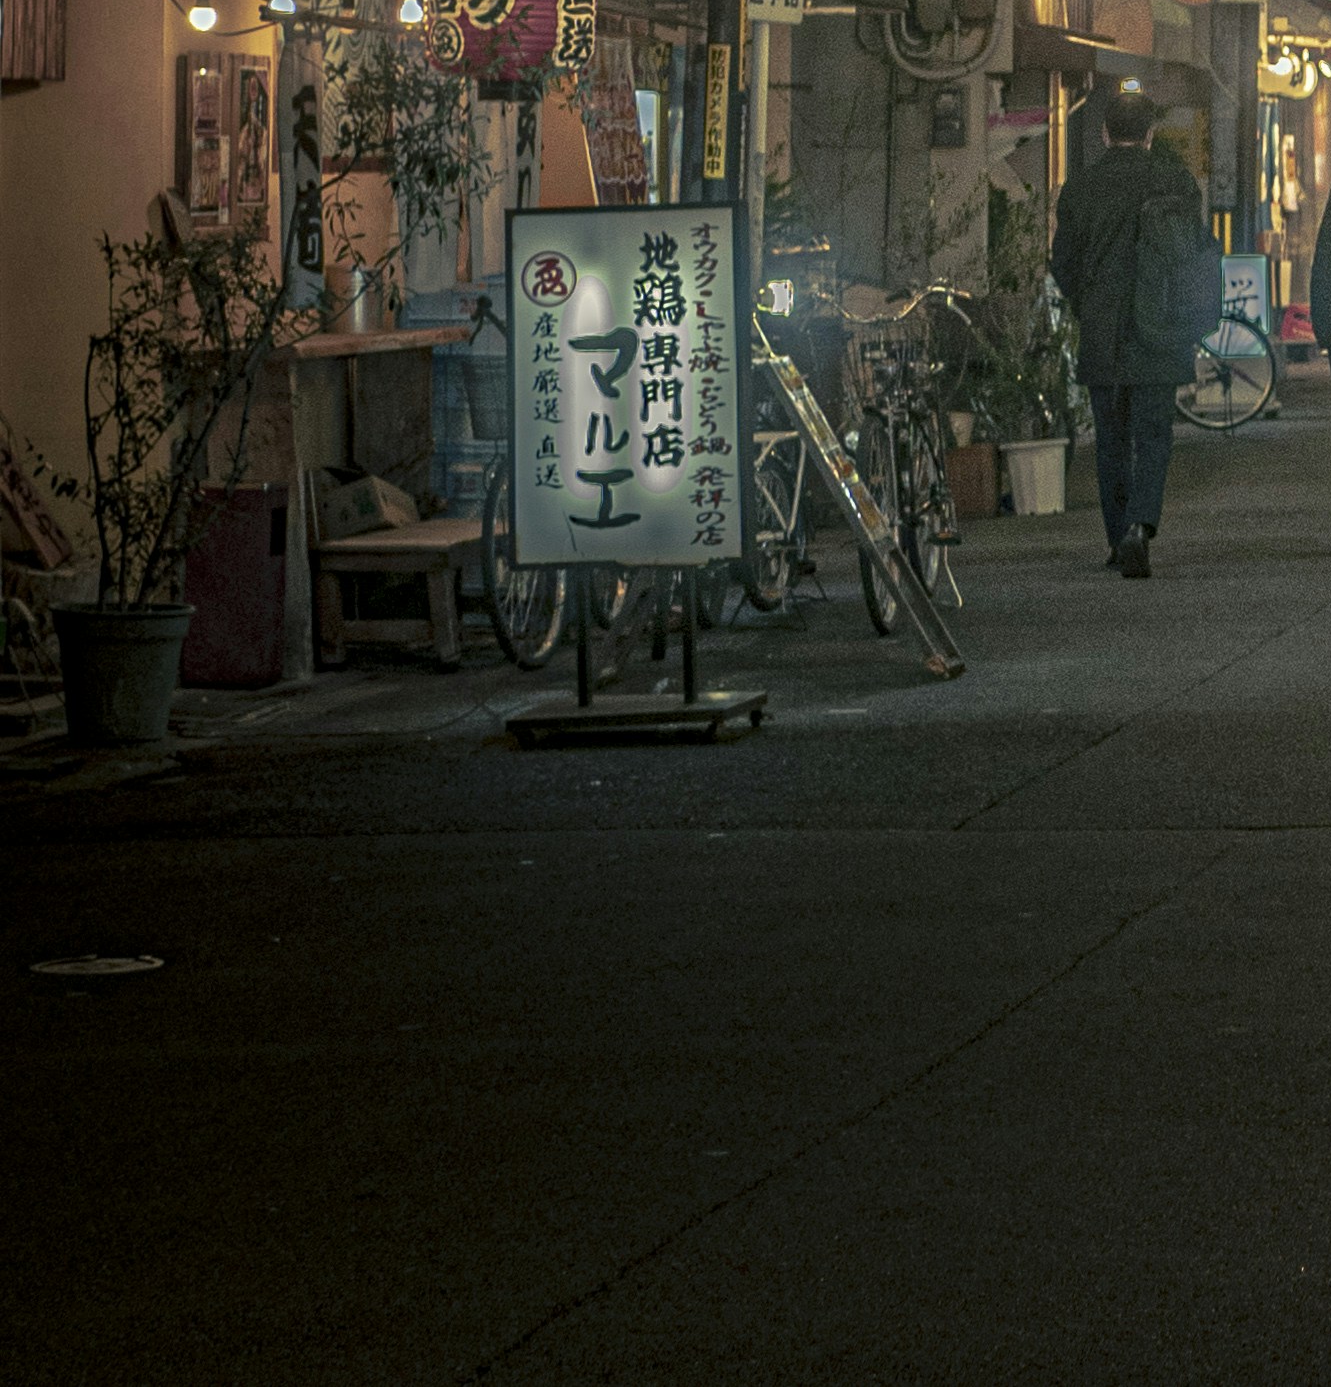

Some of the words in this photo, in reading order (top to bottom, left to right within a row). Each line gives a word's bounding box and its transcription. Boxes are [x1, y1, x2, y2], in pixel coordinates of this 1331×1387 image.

[706, 47, 726, 175] 防犯カメラ作動中
[567, 326, 641, 529] マルエ
[633, 230, 687, 469] 地鶏専門店
[535, 435, 564, 490] 直送
